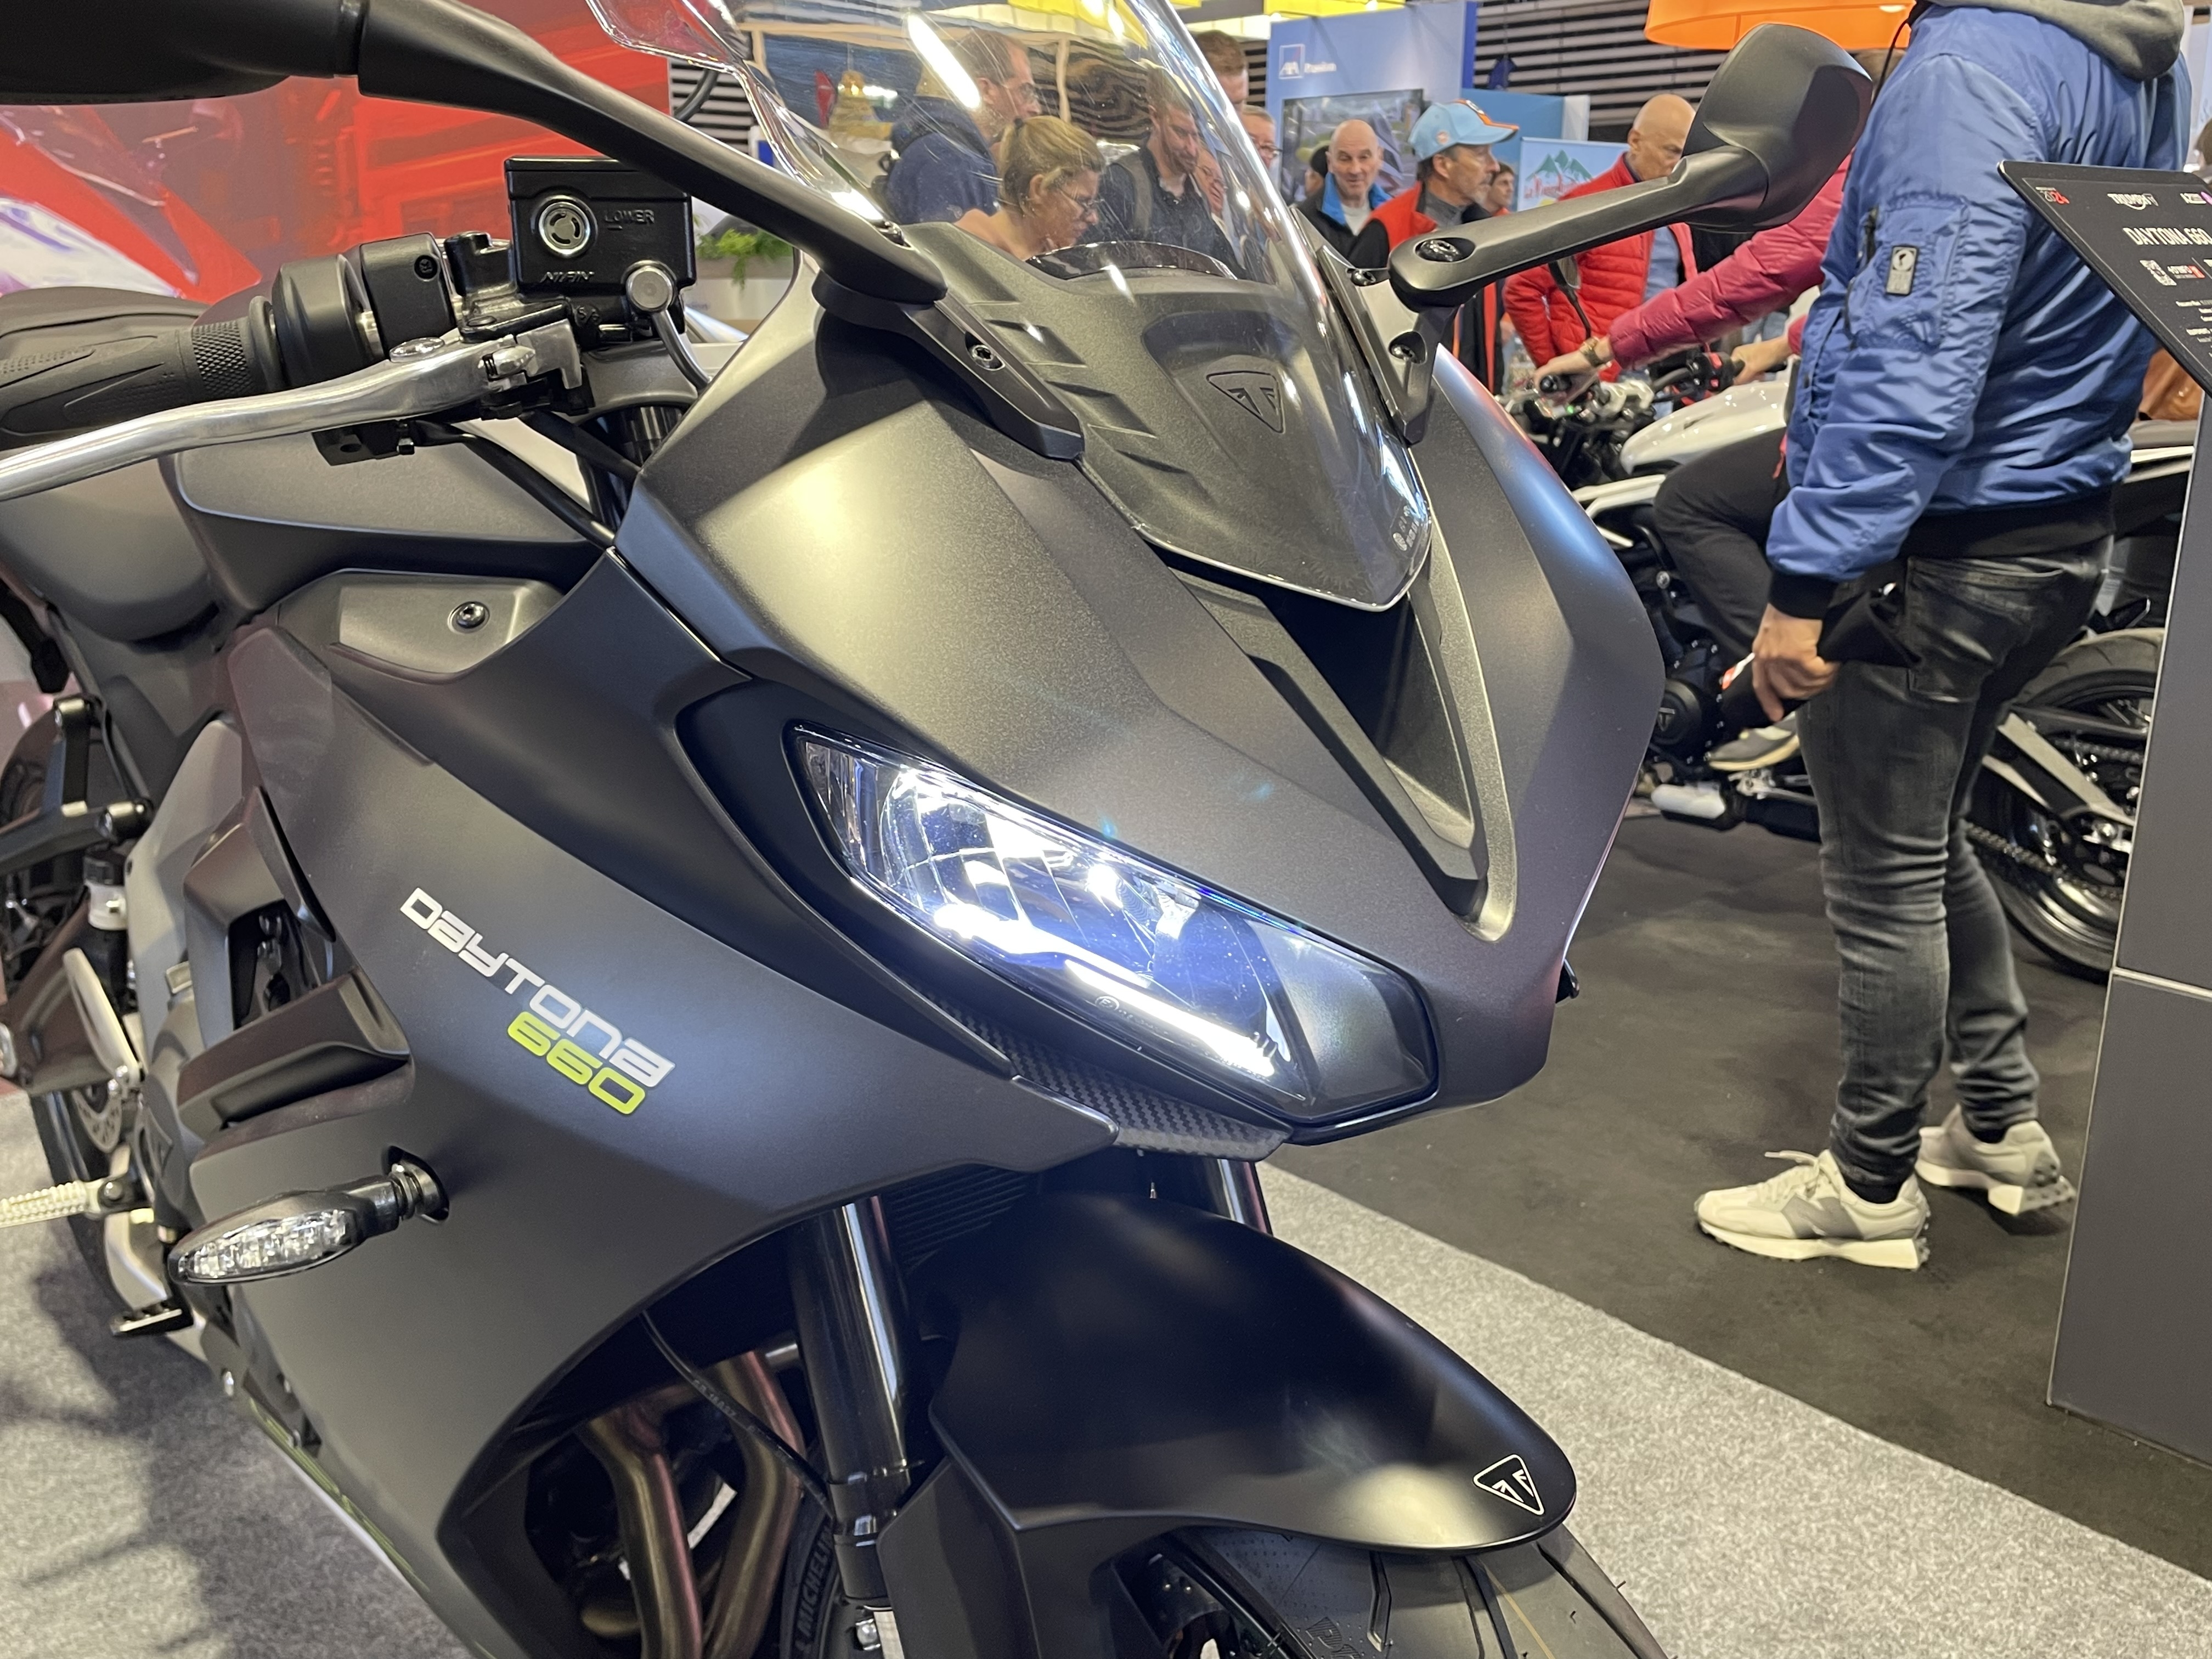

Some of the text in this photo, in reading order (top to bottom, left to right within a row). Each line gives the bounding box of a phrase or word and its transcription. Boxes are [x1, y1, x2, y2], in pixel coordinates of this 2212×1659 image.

[1279, 61, 1300, 76] AXA
[605, 209, 655, 224] LOWER
[2122, 227, 2212, 245] DAYTONA 660
[507, 1011, 646, 1115] 660
[796, 1524, 834, 1638] MICHELIN
